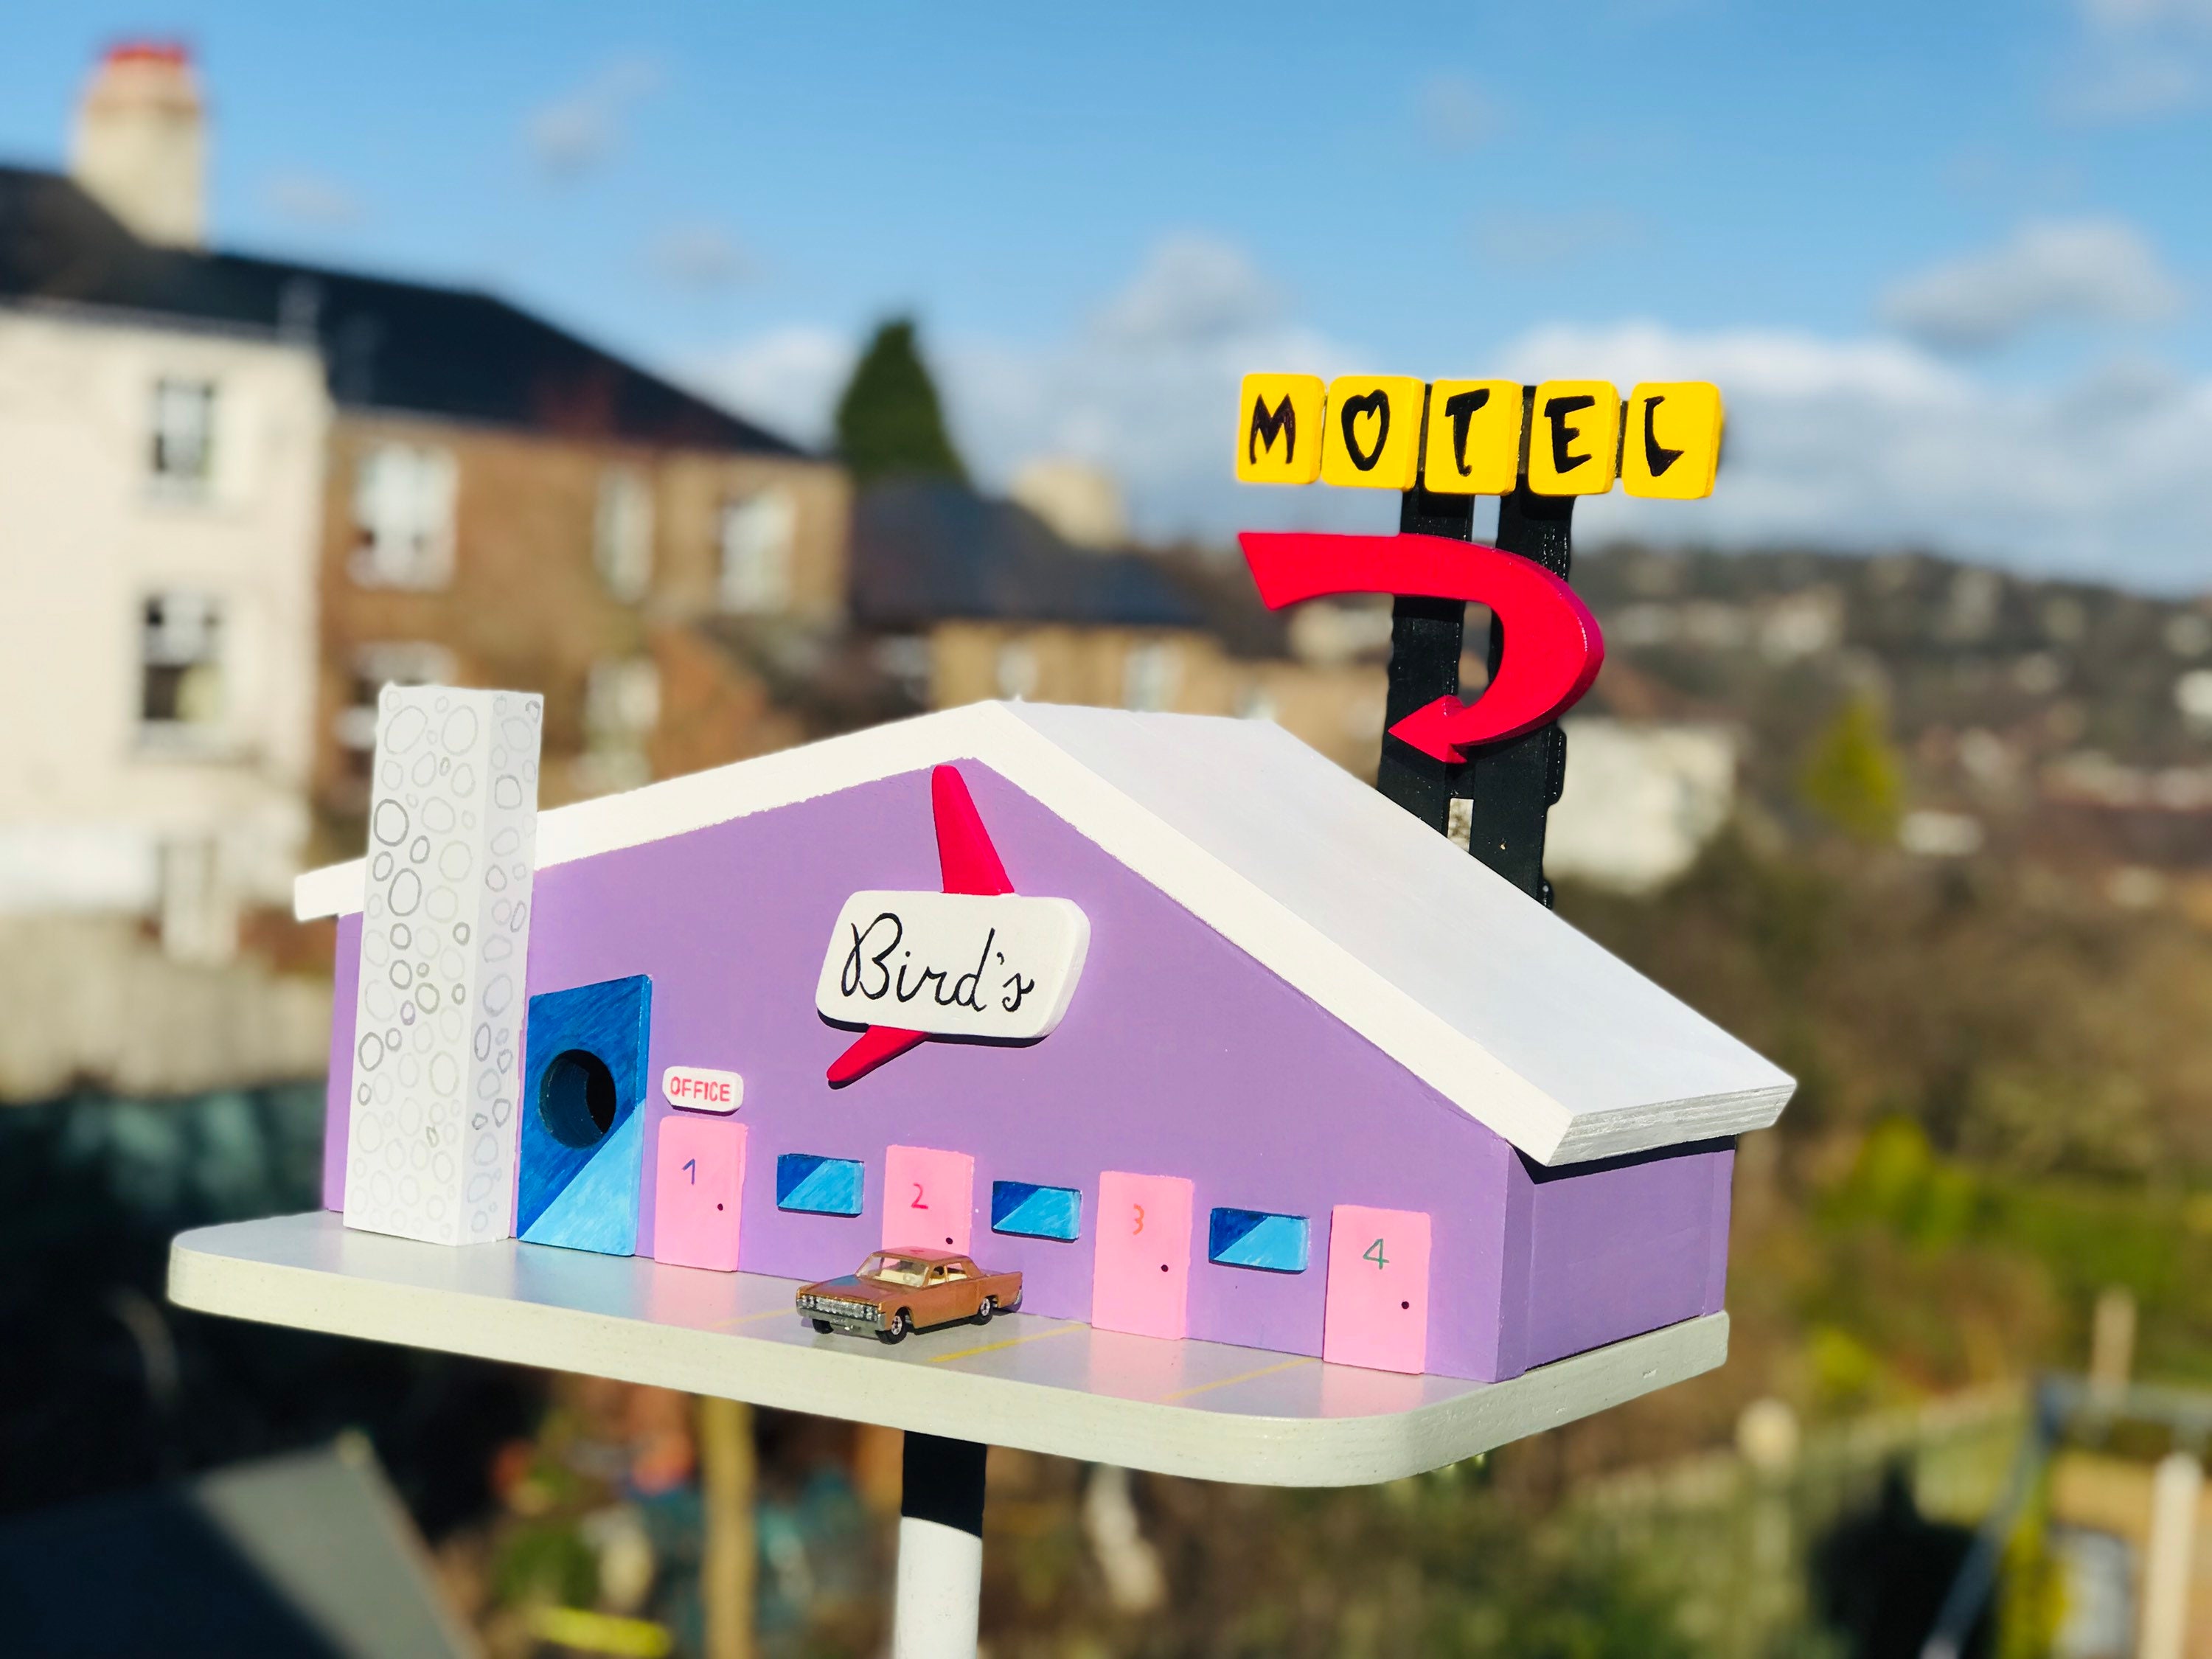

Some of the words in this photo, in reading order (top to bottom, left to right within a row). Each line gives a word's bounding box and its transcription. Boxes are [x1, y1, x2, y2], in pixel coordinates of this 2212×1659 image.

[1249, 387, 1686, 478] MOTEL
[841, 912, 1035, 1012] Bird's
[670, 1076, 731, 1102] OFFICE
[682, 1158, 695, 1186] 1
[911, 1182, 928, 1209] 2
[1133, 1203, 1144, 1235] 3
[1363, 1238, 1390, 1270] 4
